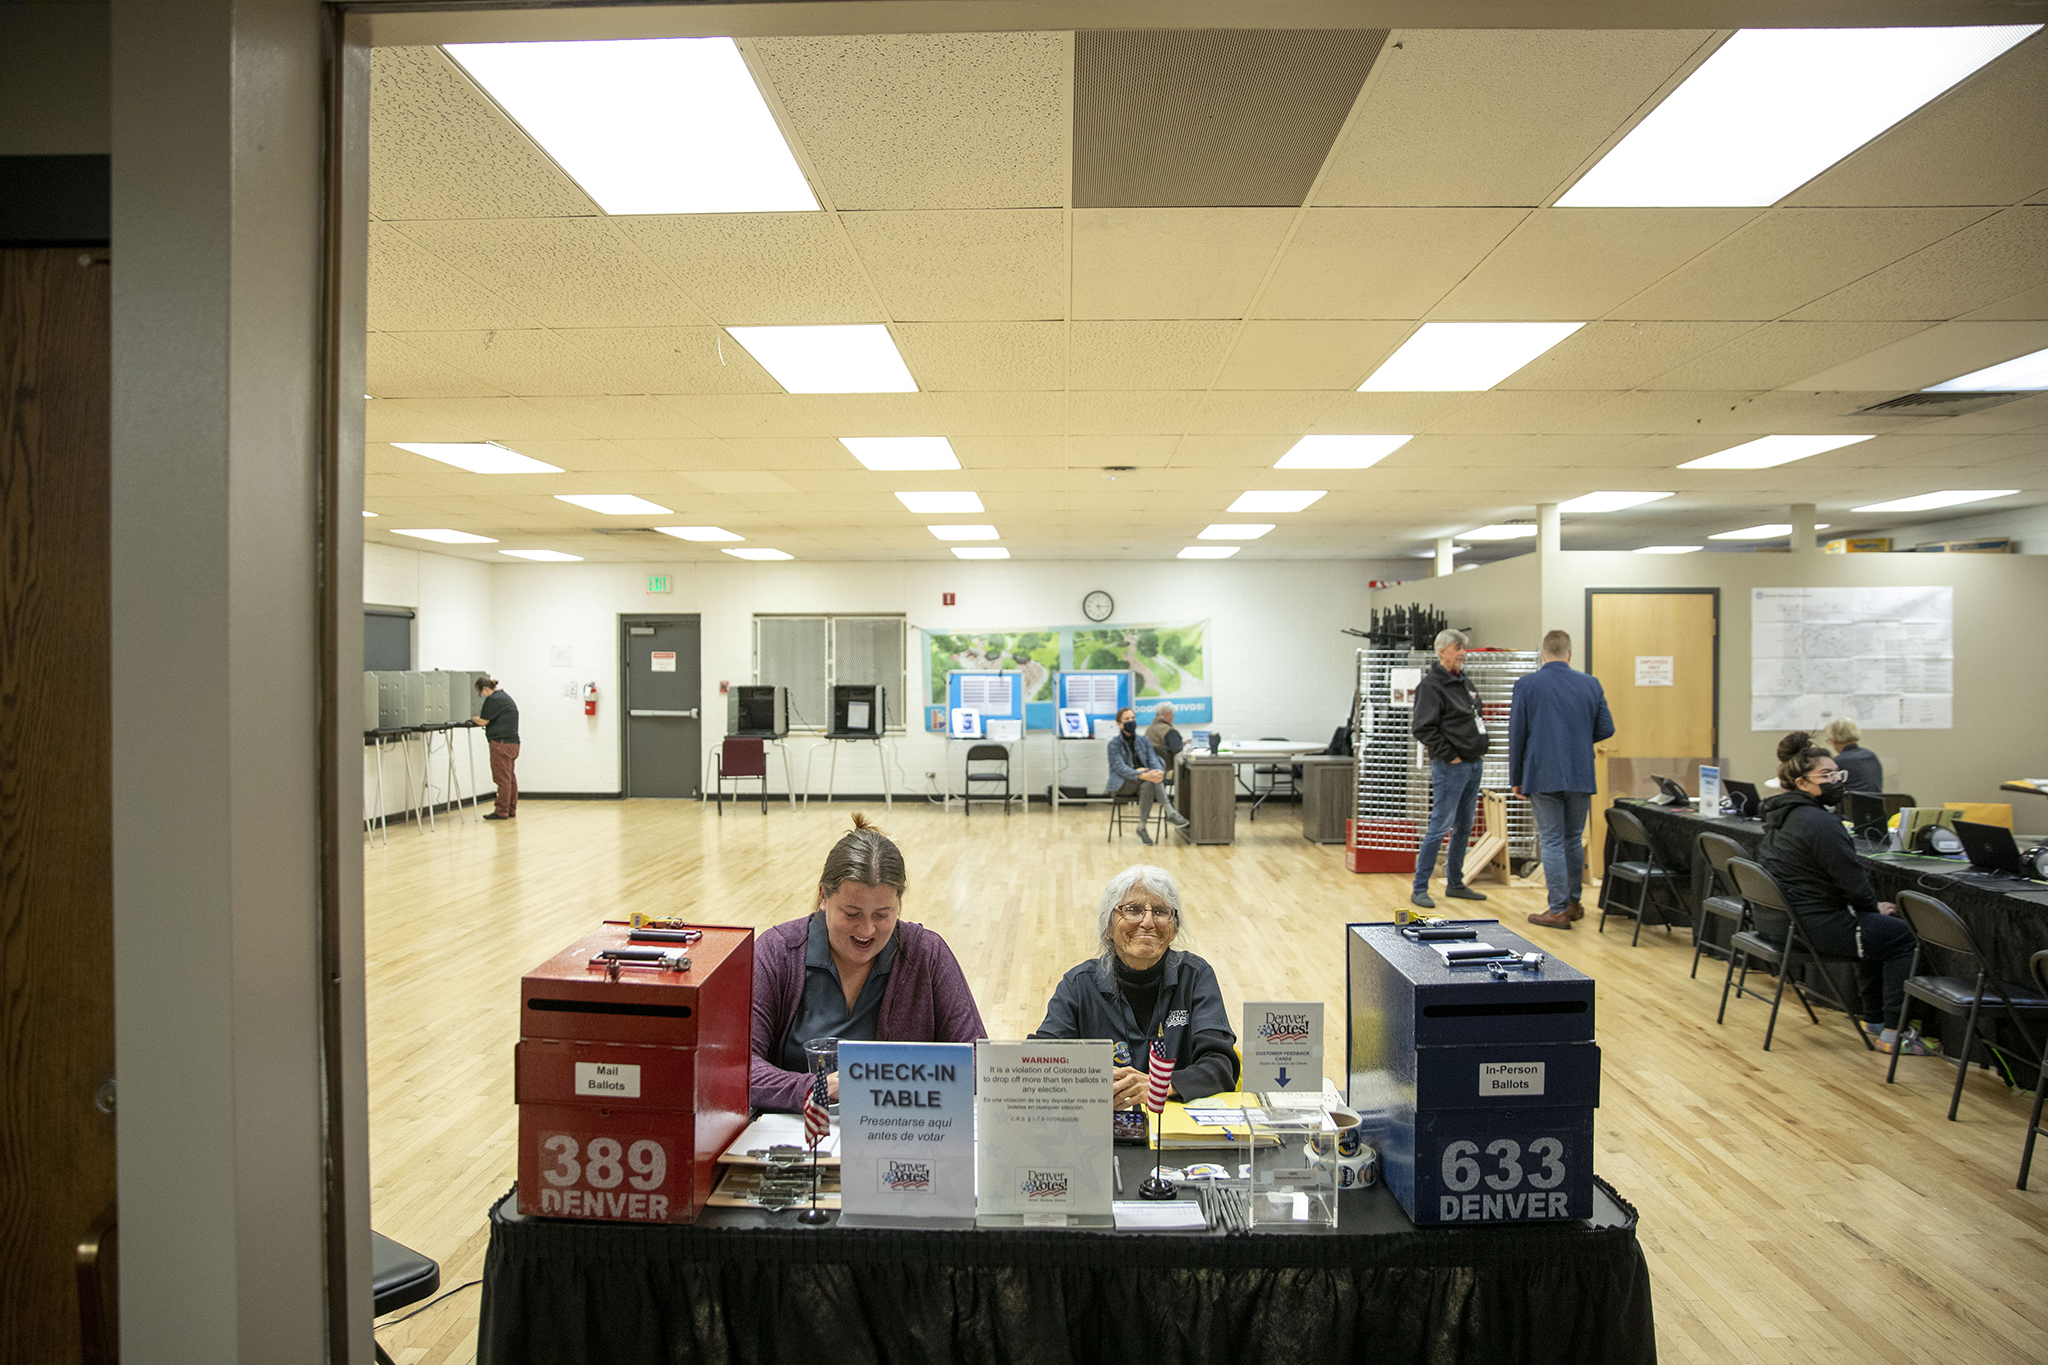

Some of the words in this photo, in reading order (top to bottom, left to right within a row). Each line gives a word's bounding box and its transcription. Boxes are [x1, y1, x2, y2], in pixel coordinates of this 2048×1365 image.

[649, 577, 667, 591] EXIT
[1265, 1012, 1306, 1024] Denver
[1271, 1021, 1309, 1034] Votes!
[1021, 1056, 1070, 1064] WARNING:
[596, 1065, 619, 1076] Mail
[849, 1062, 956, 1082] CHECK-IN
[1053, 1066, 1087, 1074] Colorado
[1486, 1065, 1538, 1075] In-Person
[588, 1079, 626, 1091] Ballots
[992, 1076, 1009, 1084] drop
[1492, 1079, 1530, 1089] Ballots
[1022, 1086, 1036, 1094] any
[1037, 1085, 1069, 1093] election.
[869, 1089, 942, 1108] TABLE
[860, 1115, 925, 1127] Presentarse
[868, 1131, 898, 1141] antes
[900, 1131, 915, 1141] de
[917, 1132, 946, 1142] votar
[543, 1134, 667, 1191] 389
[889, 1160, 927, 1172] Denver
[1441, 1137, 1566, 1192] 633
[894, 1170, 930, 1182] Votes!
[1028, 1170, 1066, 1181] Denver
[1033, 1178, 1068, 1191] Votes!
[541, 1189, 669, 1220] DENVER
[1440, 1192, 1569, 1220] DENVER
